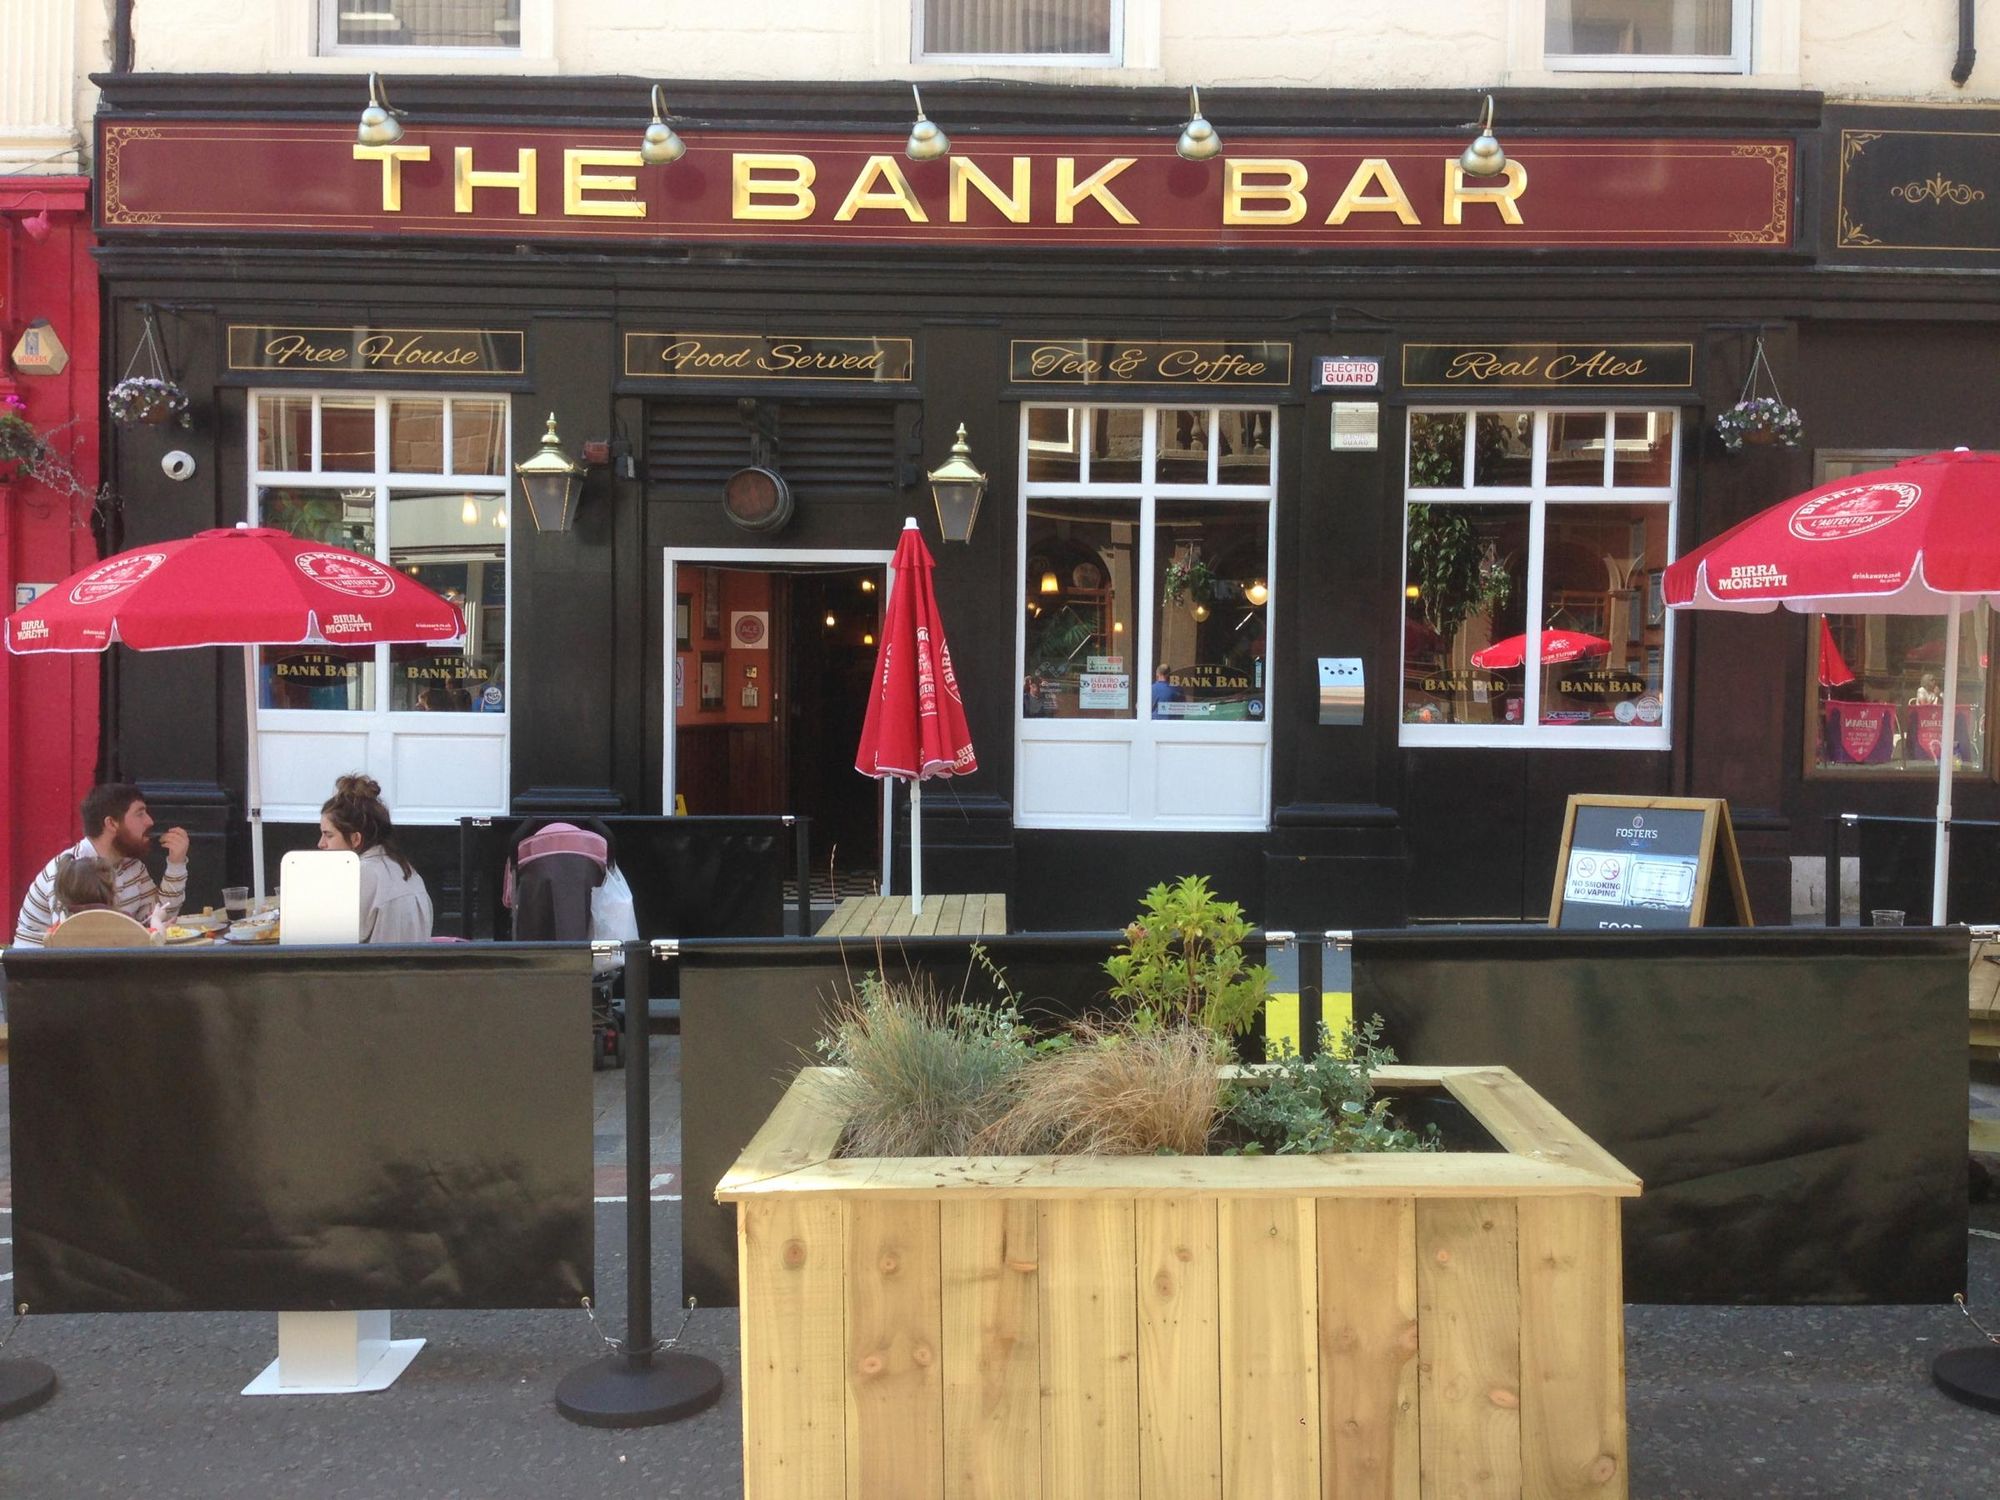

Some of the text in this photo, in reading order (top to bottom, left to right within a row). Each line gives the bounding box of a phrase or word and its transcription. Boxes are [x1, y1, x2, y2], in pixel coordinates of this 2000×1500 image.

[353, 144, 1529, 226] THE BANK BAR
[265, 335, 479, 366] Free House
[662, 341, 885, 371] Food Served
[1031, 346, 1267, 382] Tea & Coffee
[1324, 363, 1376, 373] ELECTRO
[1446, 350, 1648, 380] Real Ales
[1325, 373, 1374, 383] GUARD
[1731, 564, 1778, 578] BIRRA
[1718, 574, 1788, 590] MORETTI
[21, 619, 45, 631] BIRRA
[333, 613, 365, 625] BIRRA
[325, 622, 373, 634] MORETTI
[304, 655, 331, 664] THE
[434, 658, 460, 666] THE
[276, 664, 358, 677] BANK BAR
[407, 667, 489, 679] BANK BAR
[1195, 667, 1222, 675] THE
[1588, 671, 1615, 679] THE
[1168, 676, 1248, 688] BANK BAR
[1425, 679, 1505, 692] BANK BAR
[1560, 681, 1642, 693] BANK BAR
[1572, 879, 1621, 890] NO SMOKING
[1587, 889, 1616, 897] VAPING
[1599, 921, 1643, 929] FO
